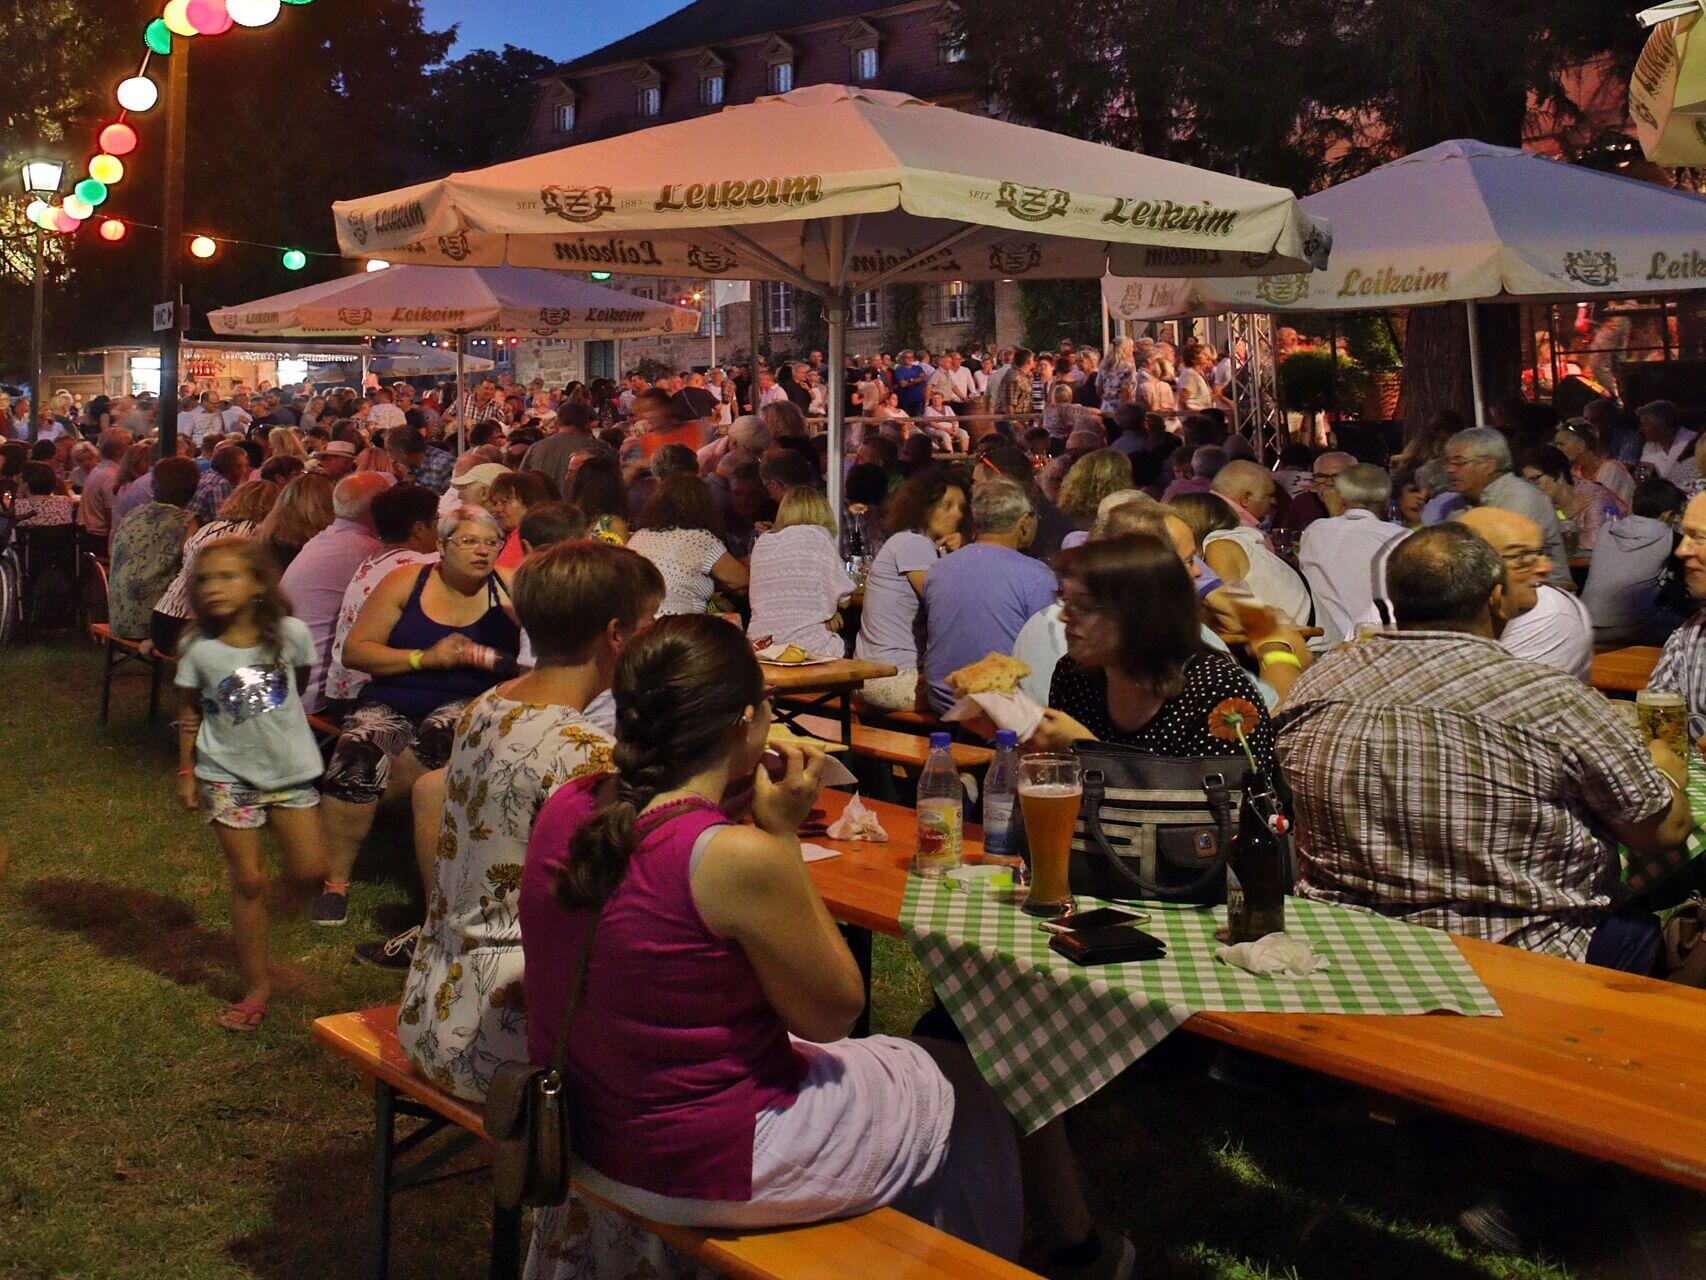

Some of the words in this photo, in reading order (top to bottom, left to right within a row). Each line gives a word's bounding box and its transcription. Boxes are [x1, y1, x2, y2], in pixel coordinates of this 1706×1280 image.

[516, 200, 537, 210] SEIT
[620, 199, 642, 209] 1887
[654, 174, 823, 213] Leikeim
[968, 189, 992, 201] SEIT
[1073, 205, 1096, 217] 1887
[1100, 195, 1240, 237] Leikeim
[1336, 264, 1450, 298] Leikeim
[155, 308, 167, 326] WC
[390, 306, 466, 323] Leikeim
[585, 307, 646, 323] Leikeim
